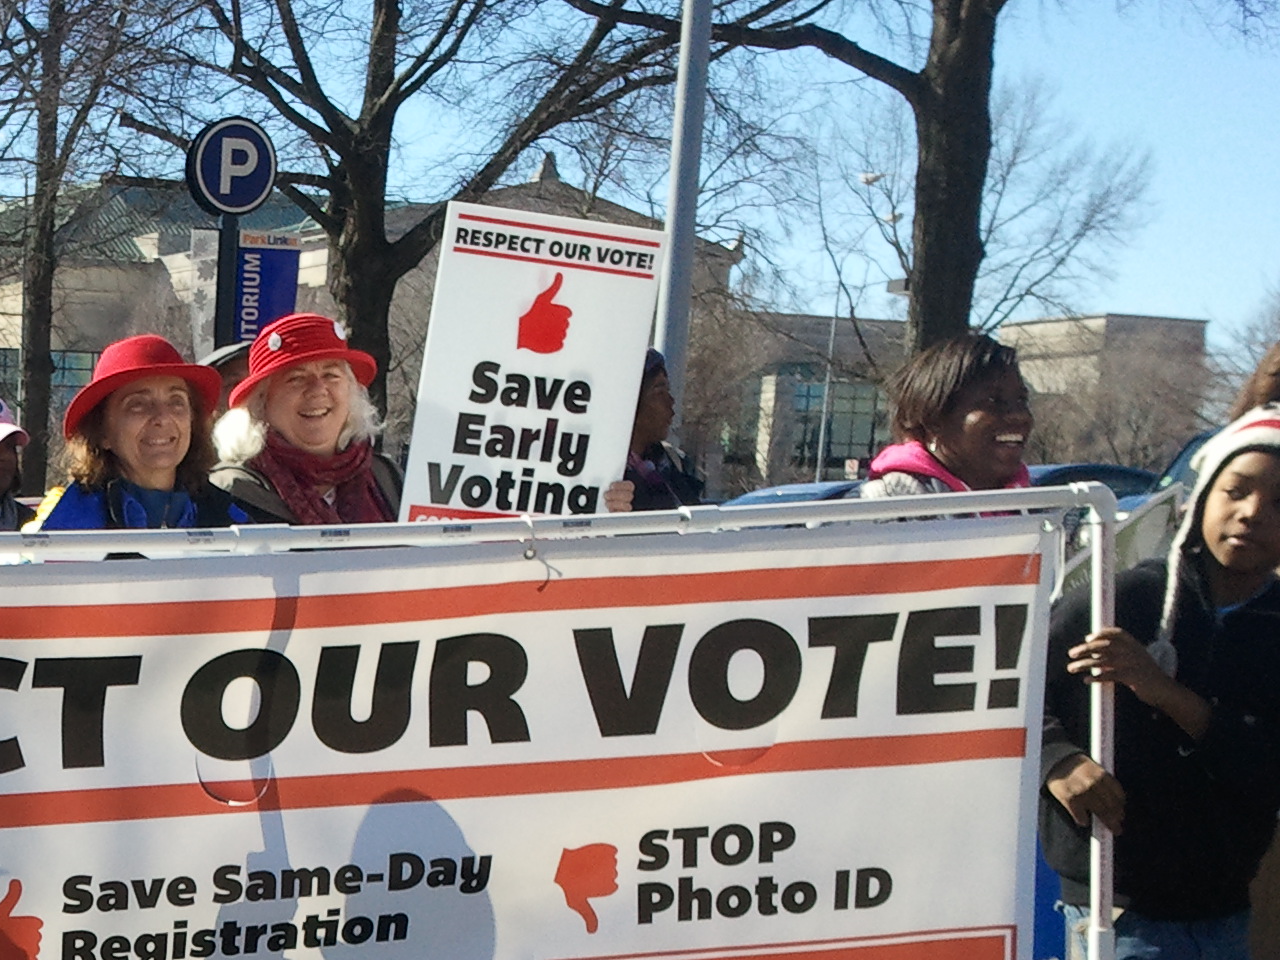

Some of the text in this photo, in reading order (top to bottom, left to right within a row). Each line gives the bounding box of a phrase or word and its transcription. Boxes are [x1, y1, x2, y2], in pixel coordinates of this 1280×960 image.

[220, 137, 258, 194] P
[455, 227, 655, 270] RESPECT OUR VOTE!
[240, 253, 261, 339] ITORIUM
[468, 361, 591, 414] Save
[452, 412, 590, 477] Early
[427, 462, 600, 515] Voting
[180, 632, 531, 761] OUR
[572, 603, 1028, 737] VOTE!
[637, 821, 796, 871] STOP
[61, 852, 493, 914] Save Same-Day
[637, 867, 893, 925] Photo ID
